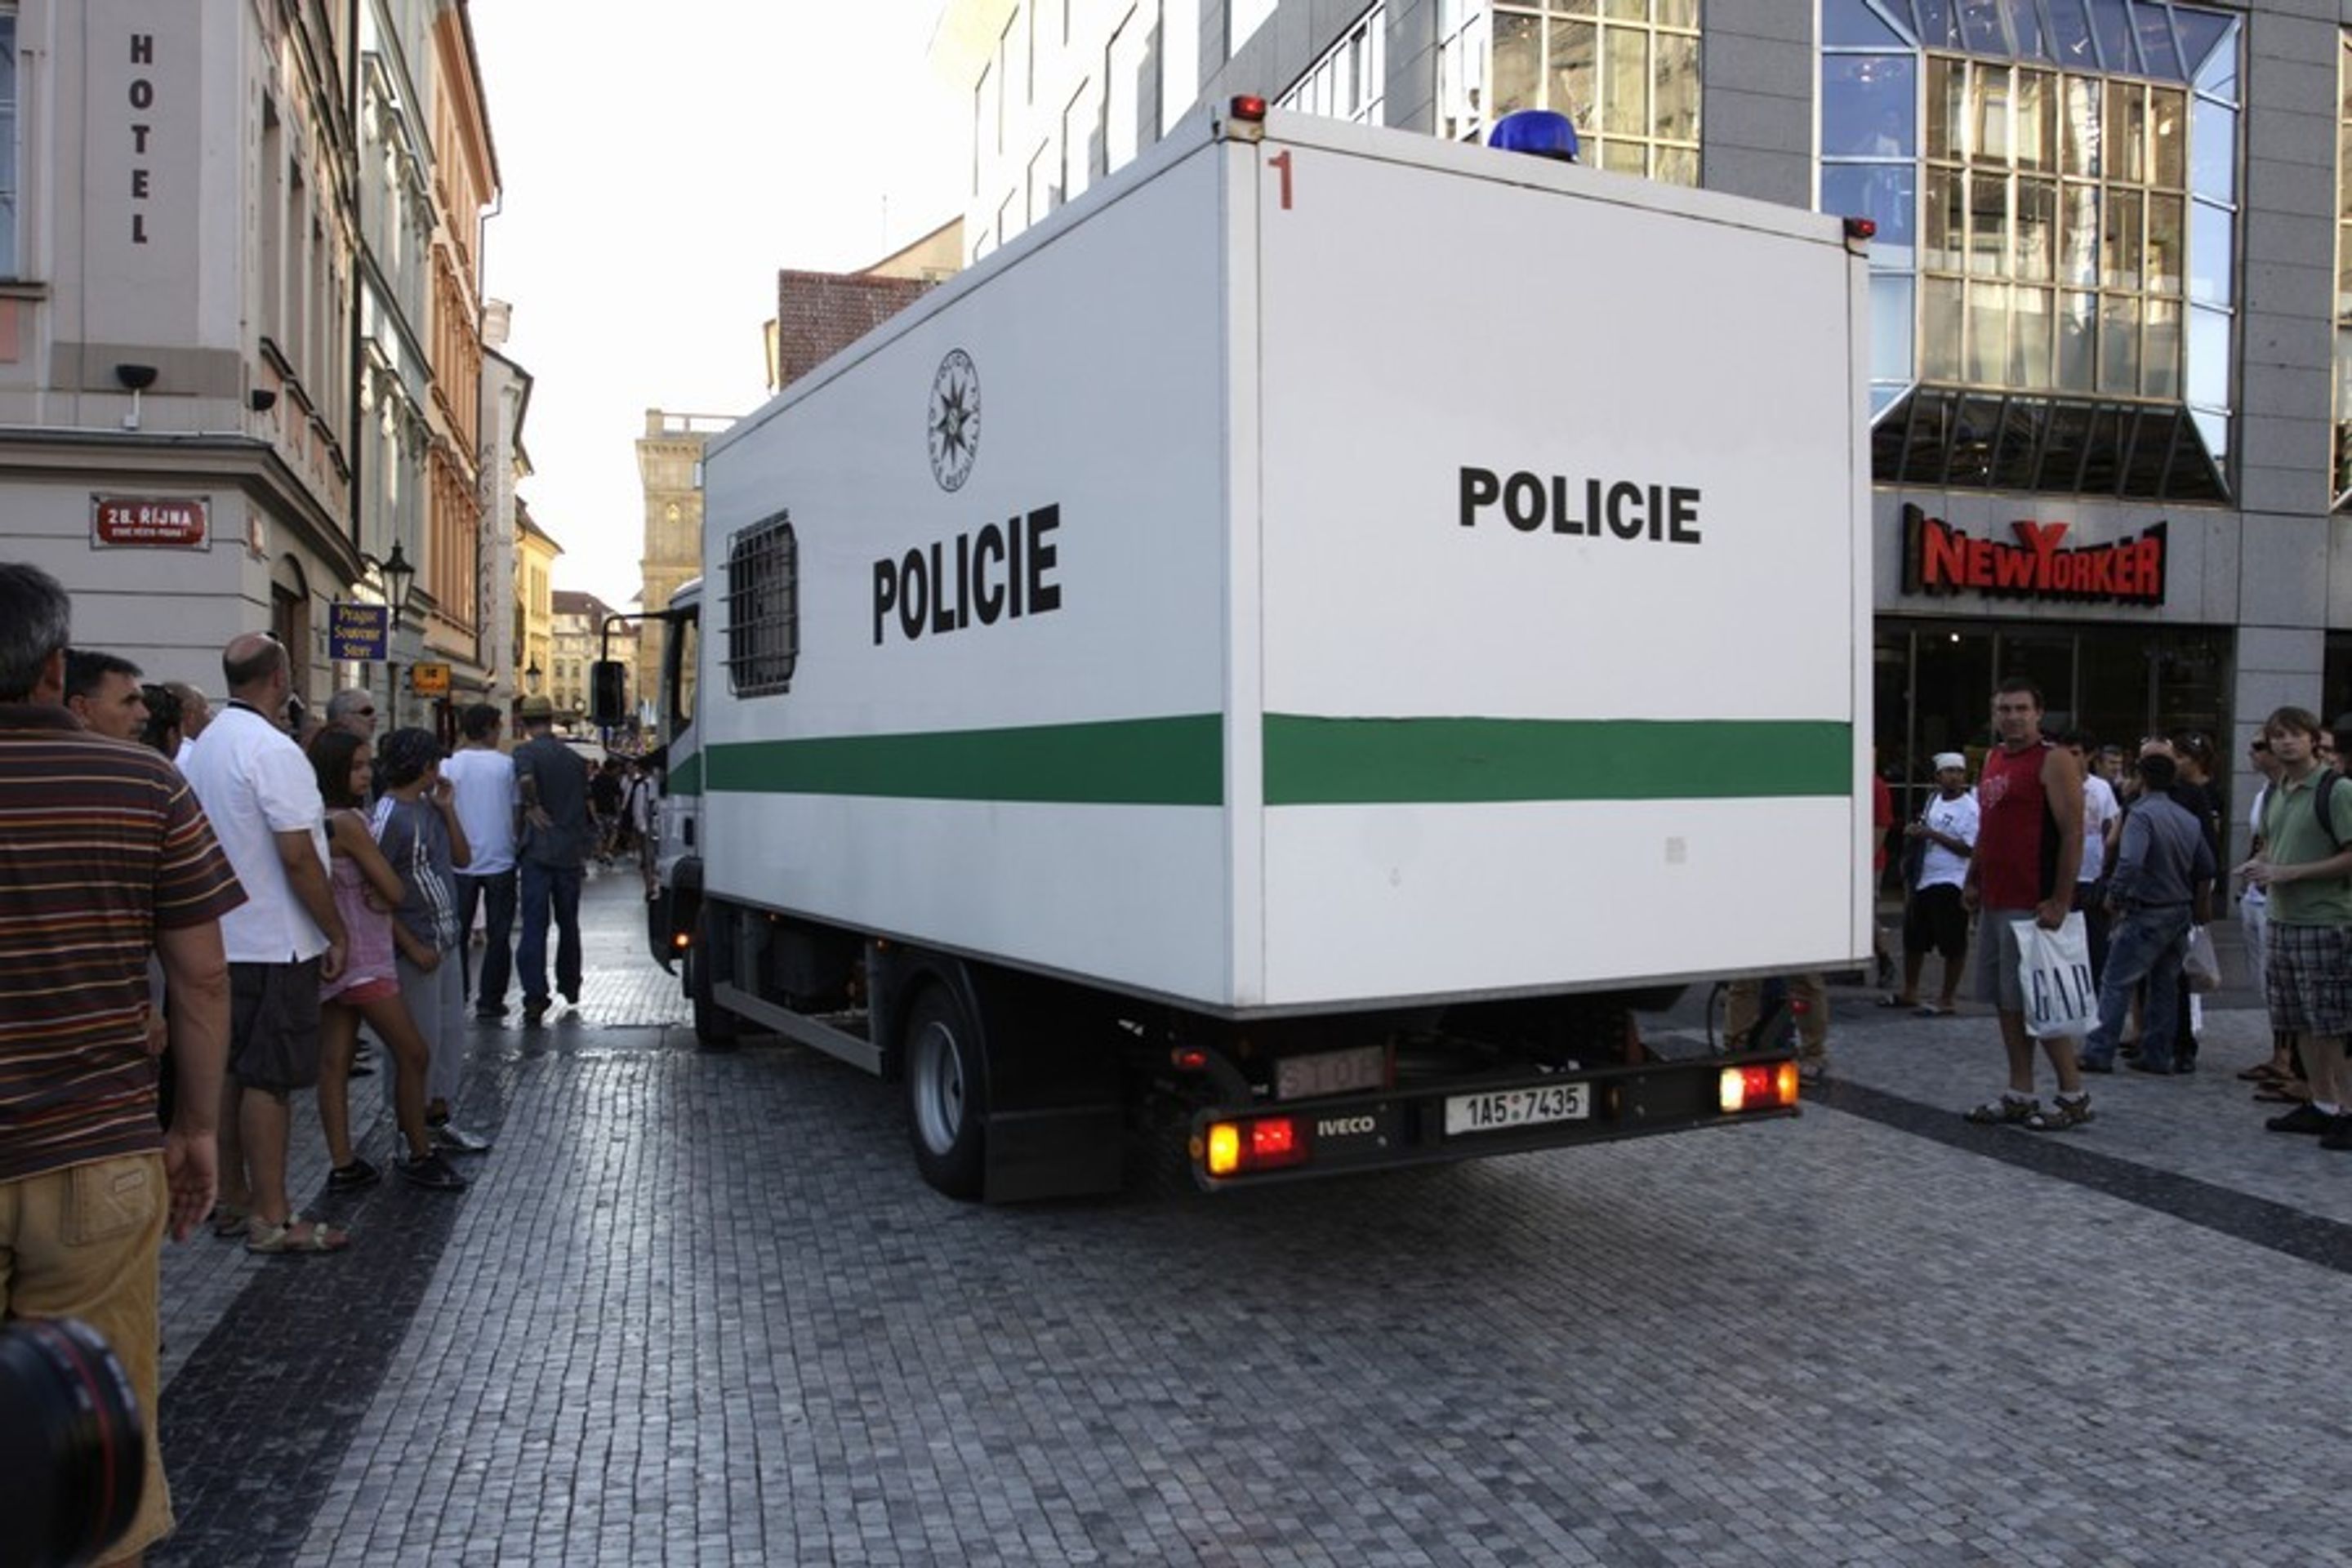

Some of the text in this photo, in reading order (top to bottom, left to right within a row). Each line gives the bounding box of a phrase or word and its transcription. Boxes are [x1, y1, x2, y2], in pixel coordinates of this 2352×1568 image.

[129, 33, 154, 244] HOTEL
[1267, 149, 1292, 210] 1
[107, 506, 192, 526] 28. ŘÍJNA
[1459, 466, 1702, 544] POLICIE
[873, 502, 1061, 646] POLICIE
[2033, 963, 2091, 1022] GAP
[1317, 1116, 1374, 1137] IVECO
